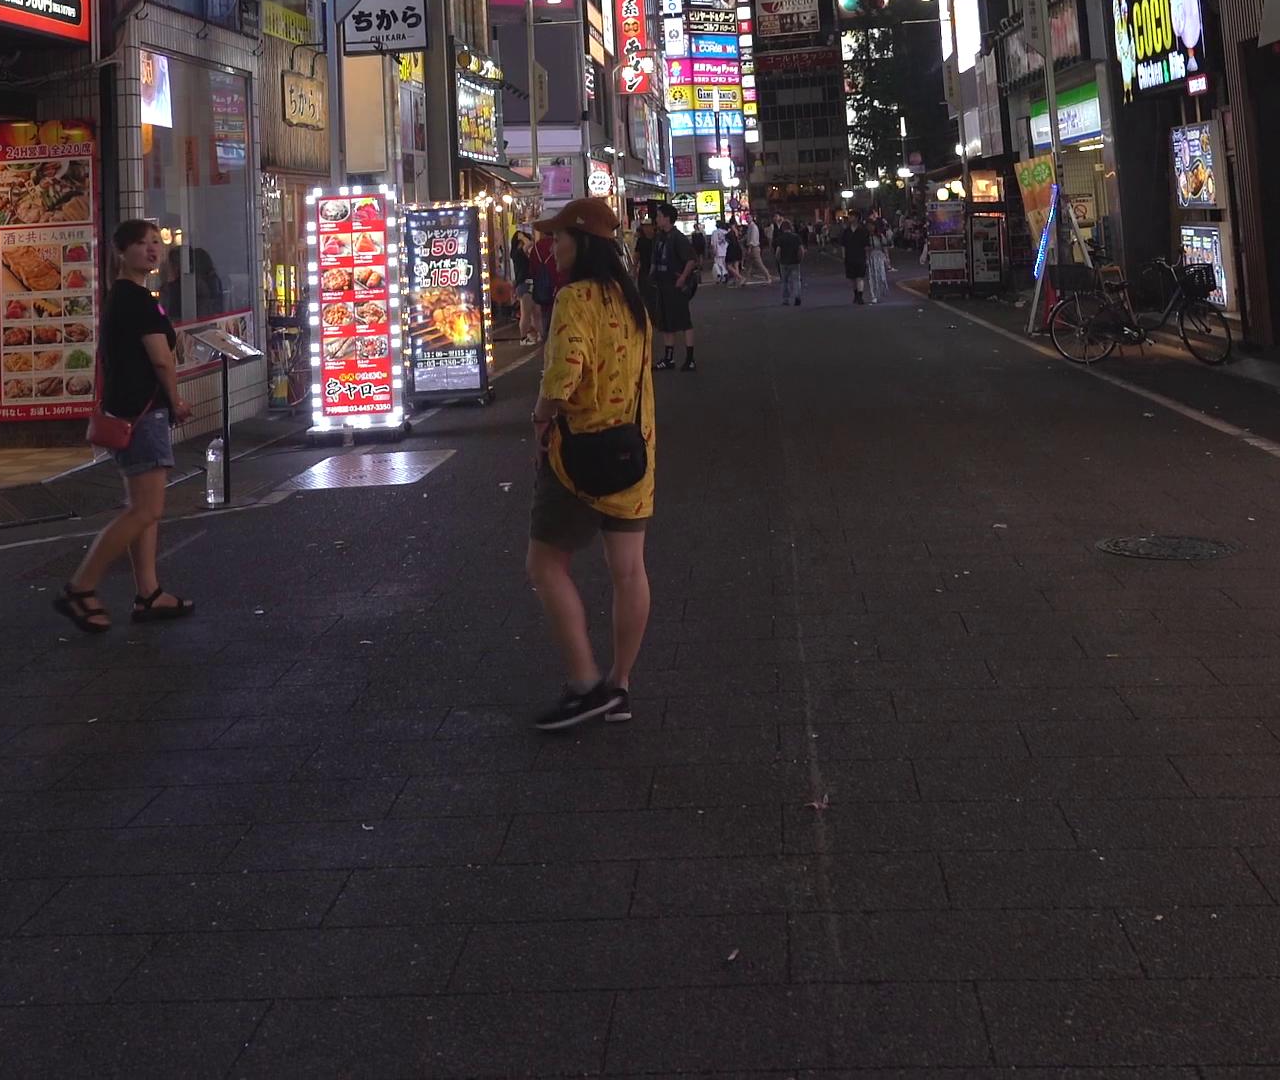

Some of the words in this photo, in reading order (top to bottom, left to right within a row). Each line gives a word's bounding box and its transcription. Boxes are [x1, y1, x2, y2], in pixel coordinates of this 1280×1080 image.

[351, 5, 422, 33] ちから
[370, 33, 407, 43] CHIKARA
[289, 83, 318, 119] ちから
[6, 144, 48, 159] 24H営業
[49, 141, 92, 158] 全220席
